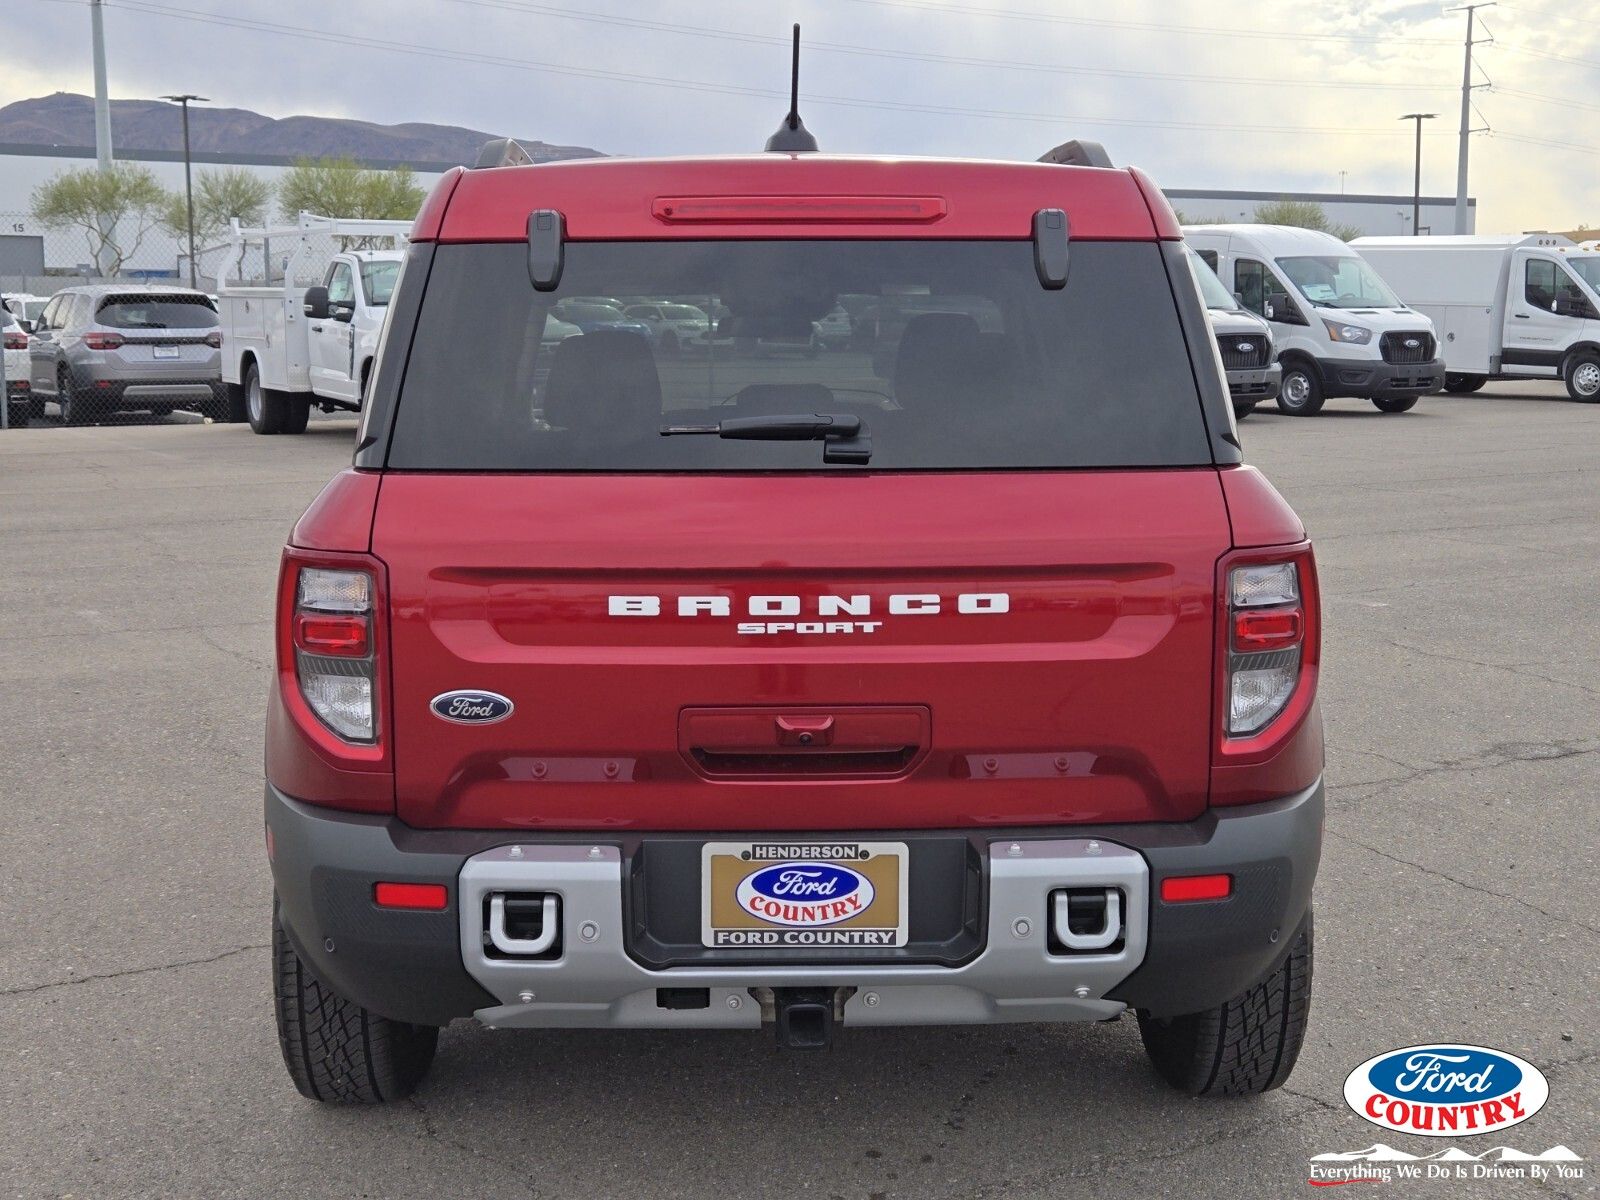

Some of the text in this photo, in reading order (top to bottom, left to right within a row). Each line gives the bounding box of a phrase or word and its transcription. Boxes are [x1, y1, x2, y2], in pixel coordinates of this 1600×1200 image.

[12, 223, 25, 233] 15
[608, 593, 1010, 617] BRONCO
[737, 621, 883, 635] SPORT
[448, 697, 495, 717] Ford
[755, 846, 856, 859] HENDERSON
[772, 869, 839, 896] Ford
[749, 893, 862, 922] COUNTRY
[716, 931, 896, 944] FORD COUNTRY
